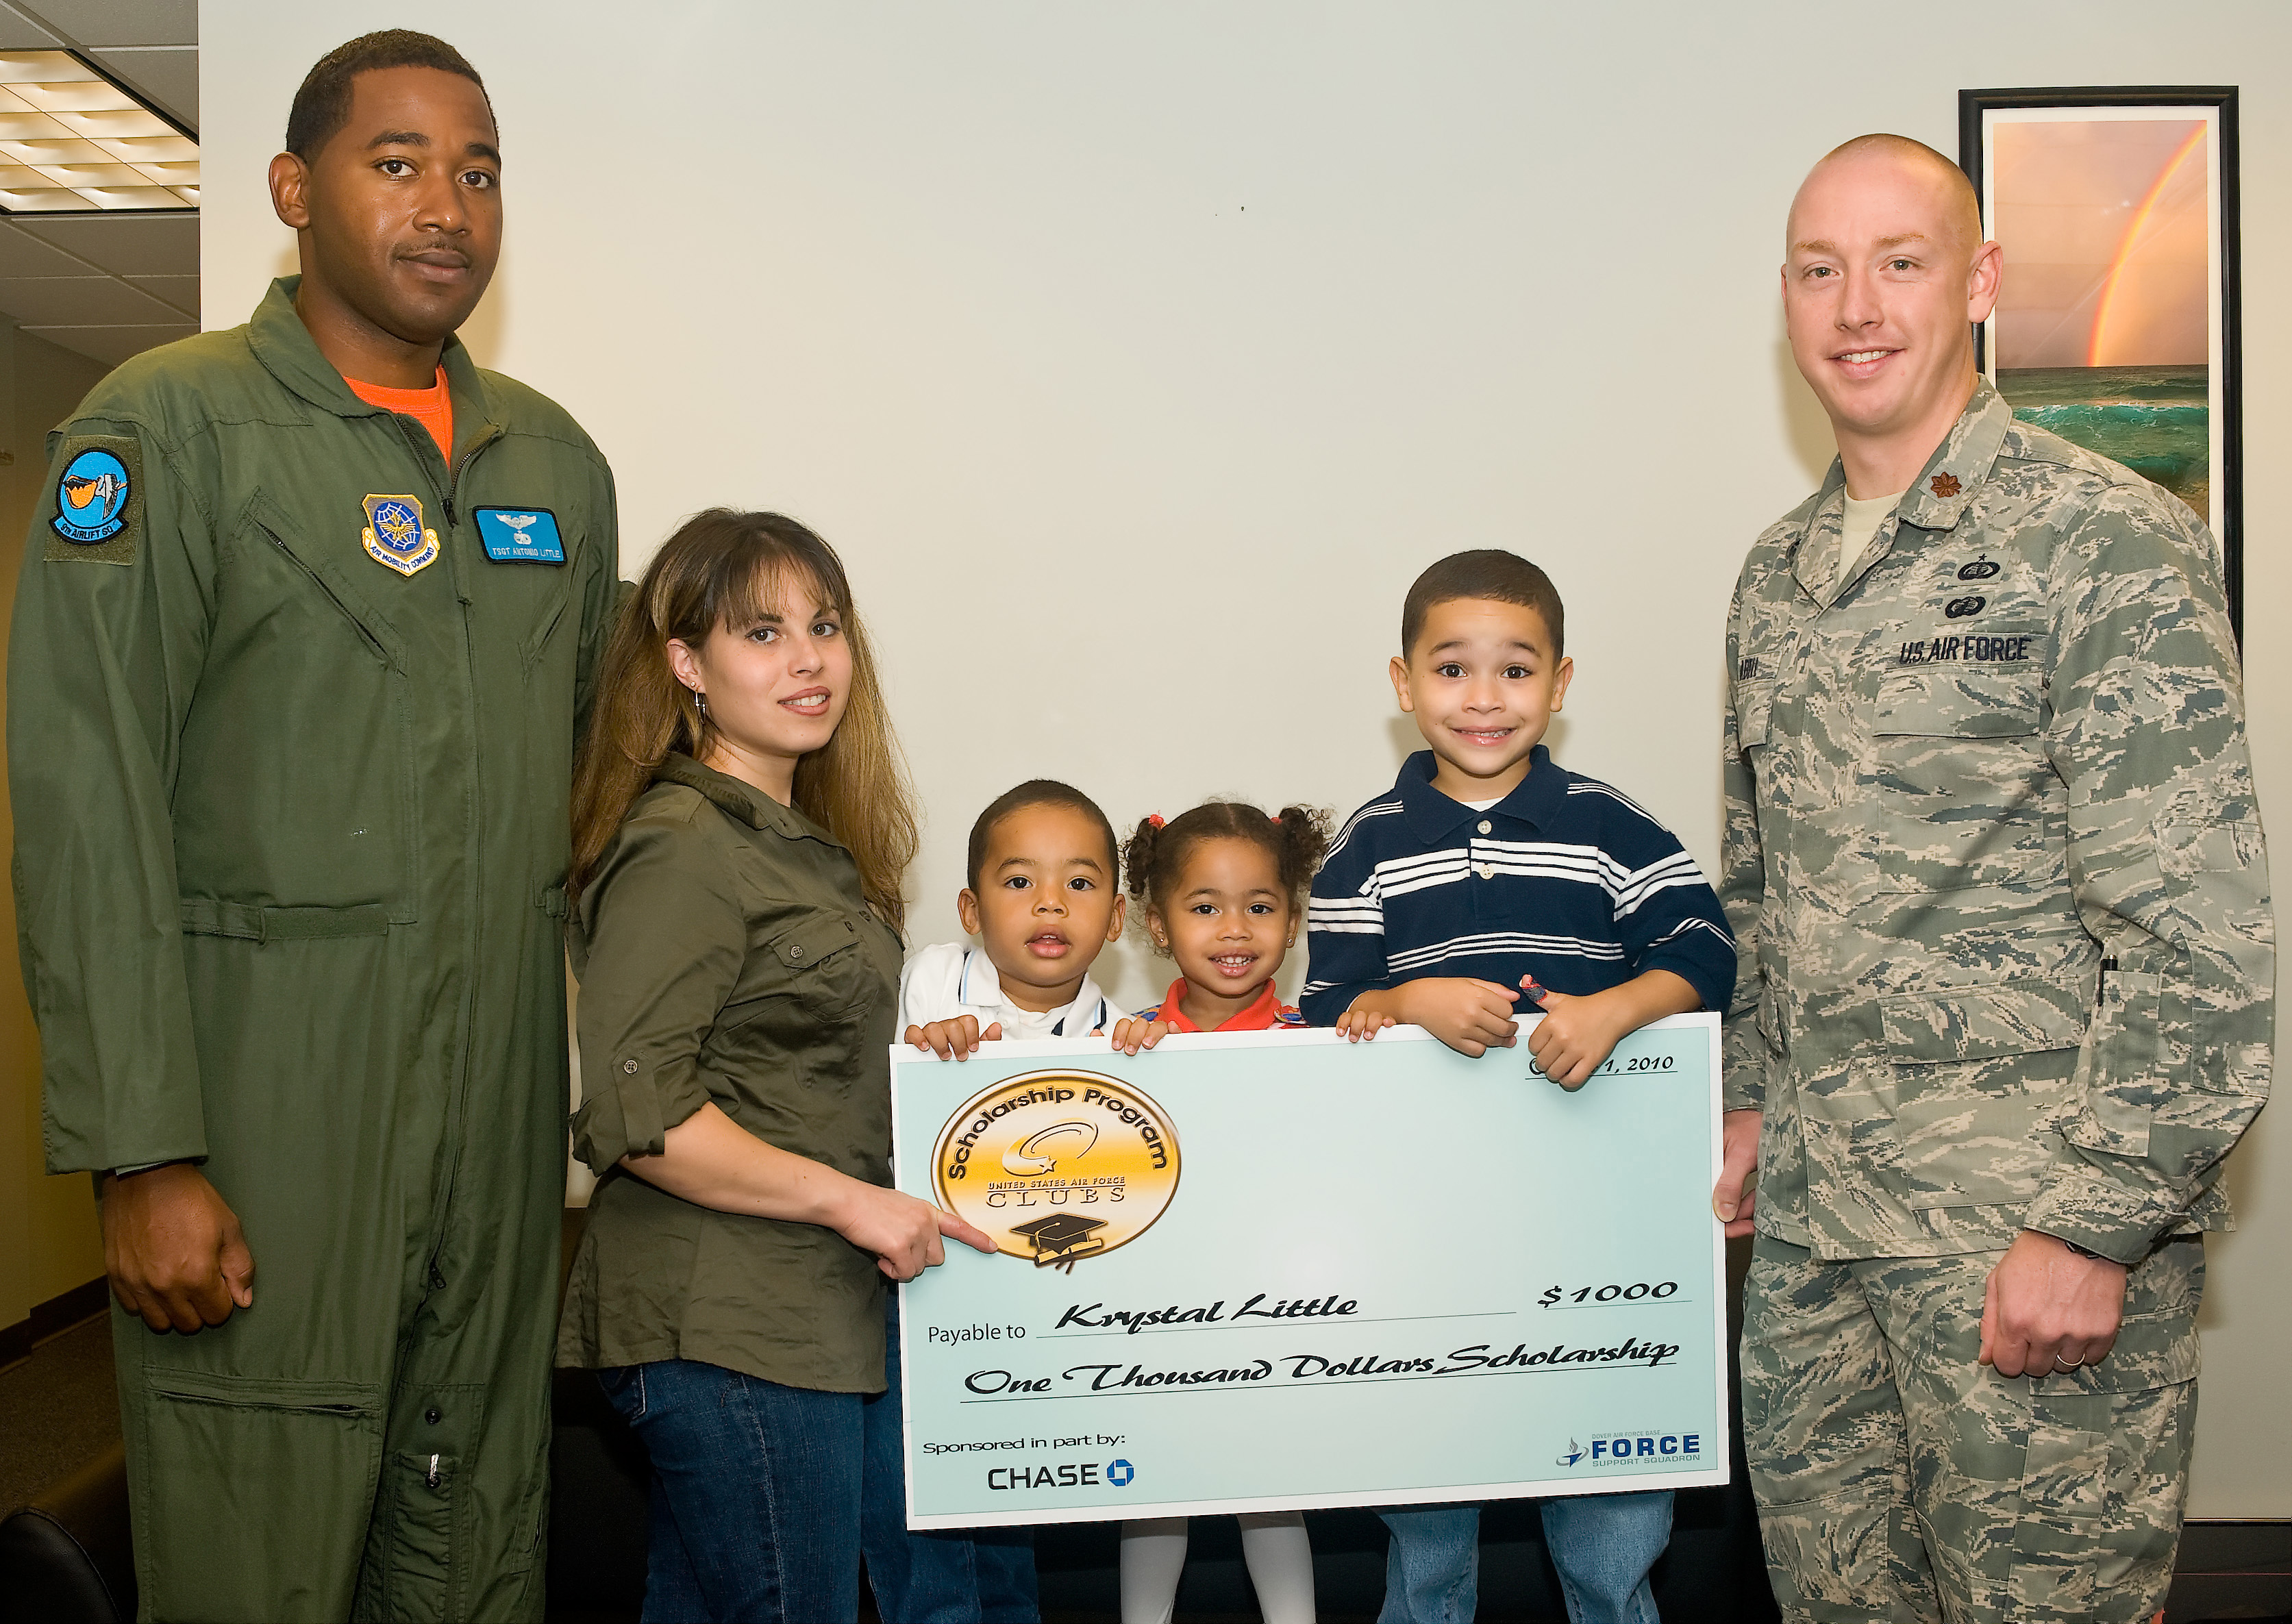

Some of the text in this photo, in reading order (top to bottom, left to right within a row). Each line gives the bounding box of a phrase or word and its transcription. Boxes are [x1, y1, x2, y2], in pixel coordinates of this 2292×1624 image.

[71, 529, 100, 539] AIRLIFT
[102, 525, 114, 536] SQ
[370, 546, 435, 571] AIR MOBILITY COMMAND
[493, 547, 561, 558] TSGT ANTONIO LITTLE
[1899, 636, 2032, 664] U.S. AIR FORCE
[1627, 1055, 1673, 1071] 2010
[949, 1086, 1168, 1179] Scholarship Program
[988, 1176, 1125, 1190] UNITED STATES AIR FORCE
[986, 1186, 1125, 1208] CLUBS
[928, 1323, 1001, 1346] Payable
[1006, 1325, 1026, 1339] to
[1054, 1303, 1225, 1335] Krystal
[1230, 1293, 1358, 1321] Little
[964, 1337, 1680, 1394] One Thousand Dollars Scholarship
[923, 1434, 1125, 1455] Sponsored in part by:
[1592, 1434, 1700, 1460] FORCE
[1592, 1454, 1700, 1467] SUPPORT SQUADRON
[987, 1463, 1100, 1490] CHASE
